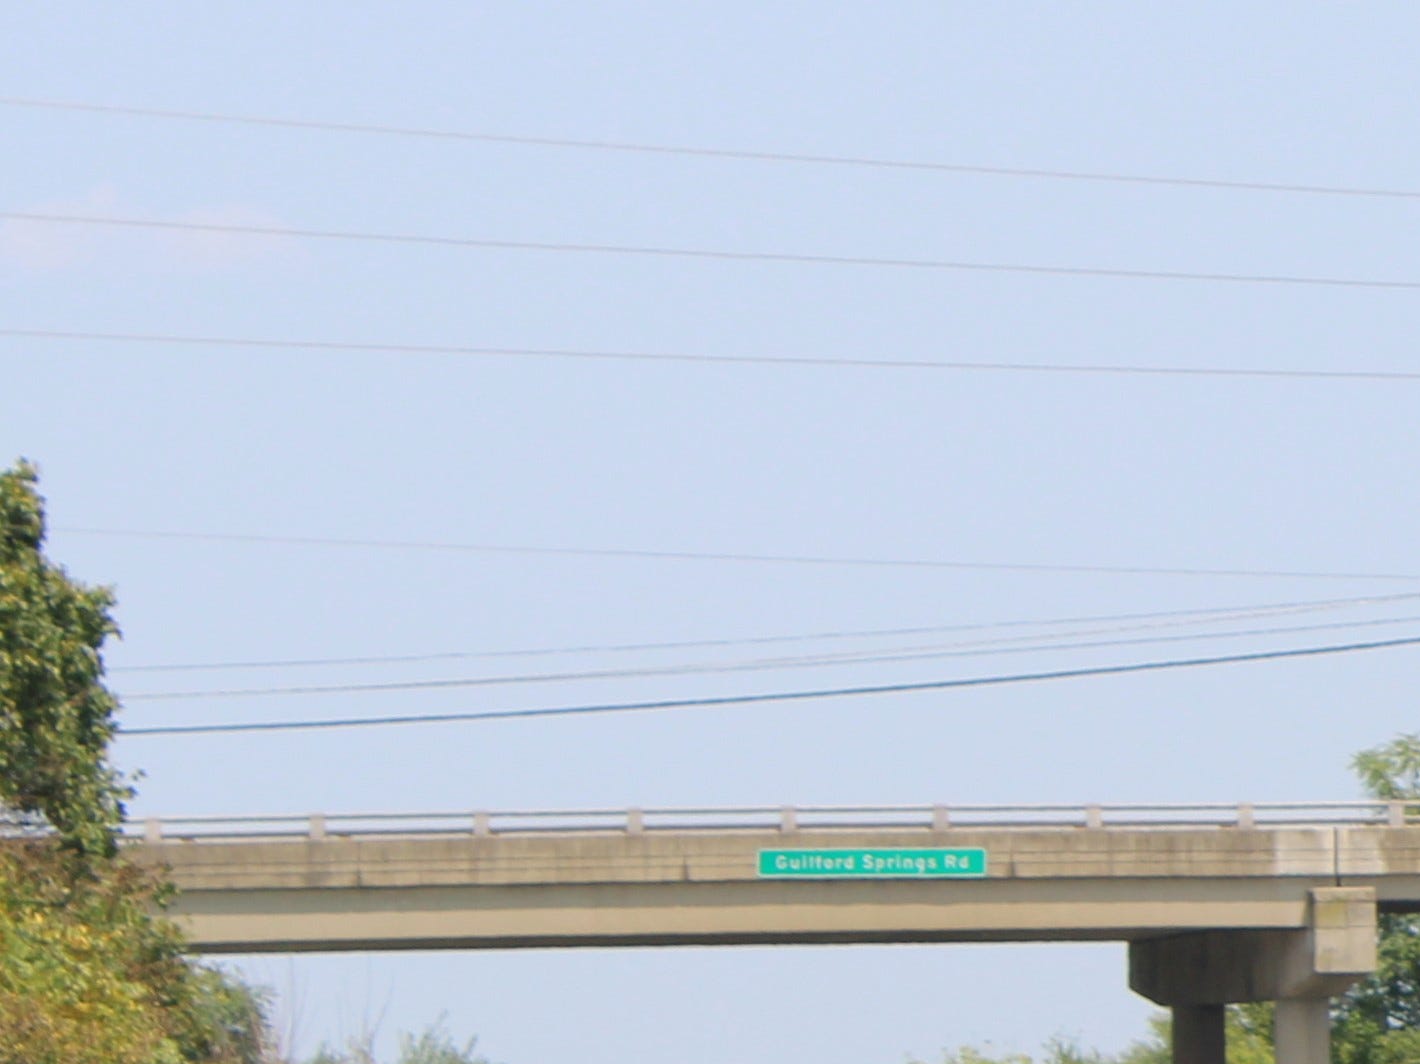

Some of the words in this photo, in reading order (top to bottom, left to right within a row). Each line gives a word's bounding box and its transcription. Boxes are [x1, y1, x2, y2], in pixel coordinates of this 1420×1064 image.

[775, 854, 854, 870] Guilford
[862, 854, 938, 873] Springs
[944, 854, 969, 870] Rd
